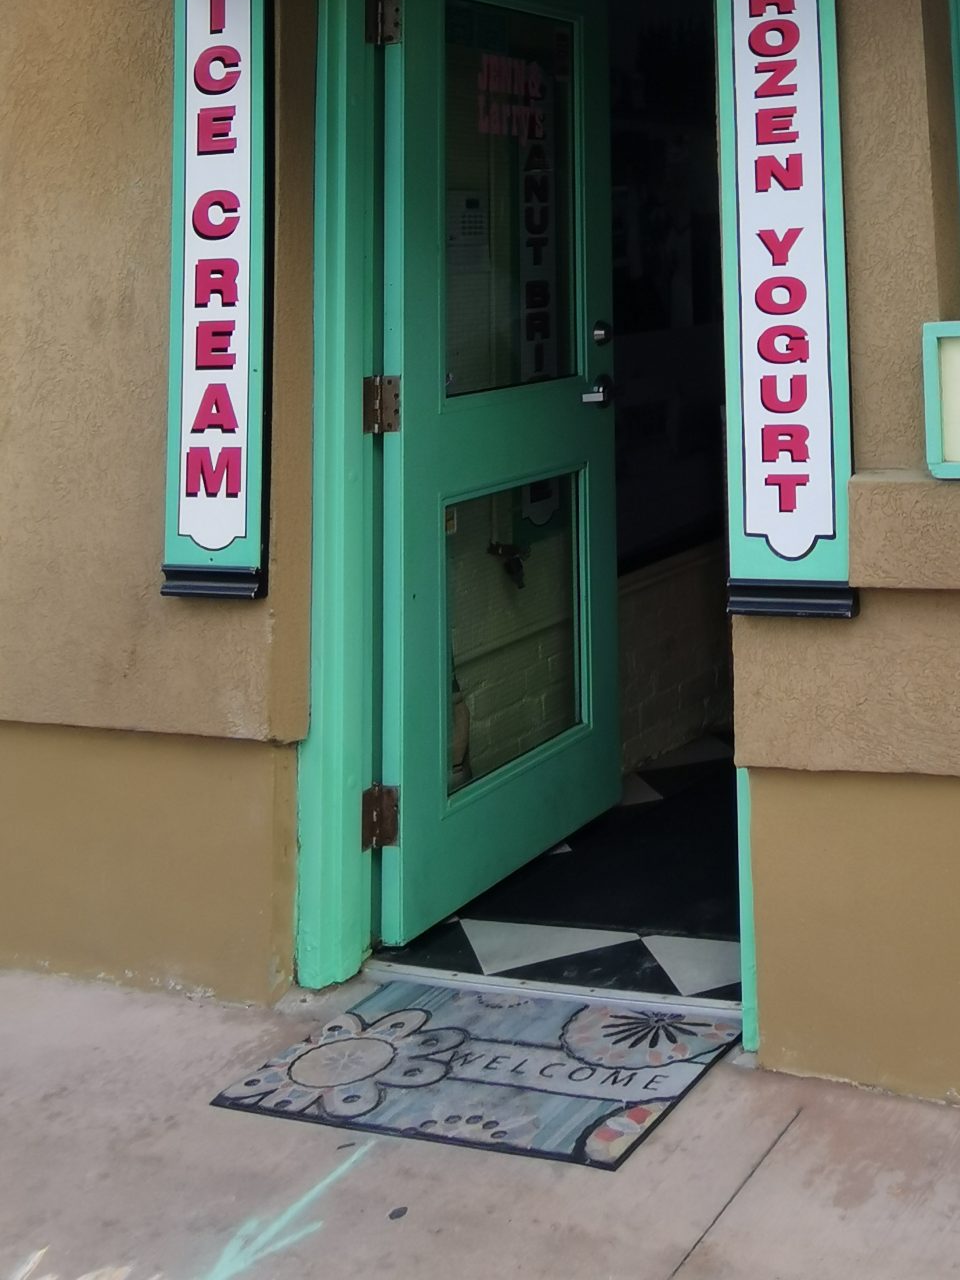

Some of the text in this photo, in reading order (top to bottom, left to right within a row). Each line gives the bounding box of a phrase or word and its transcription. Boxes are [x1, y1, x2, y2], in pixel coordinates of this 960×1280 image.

[185, 189, 242, 498] CREAM
[755, 227, 809, 513] YOGURT
[447, 1049, 670, 1092] WELCOME
